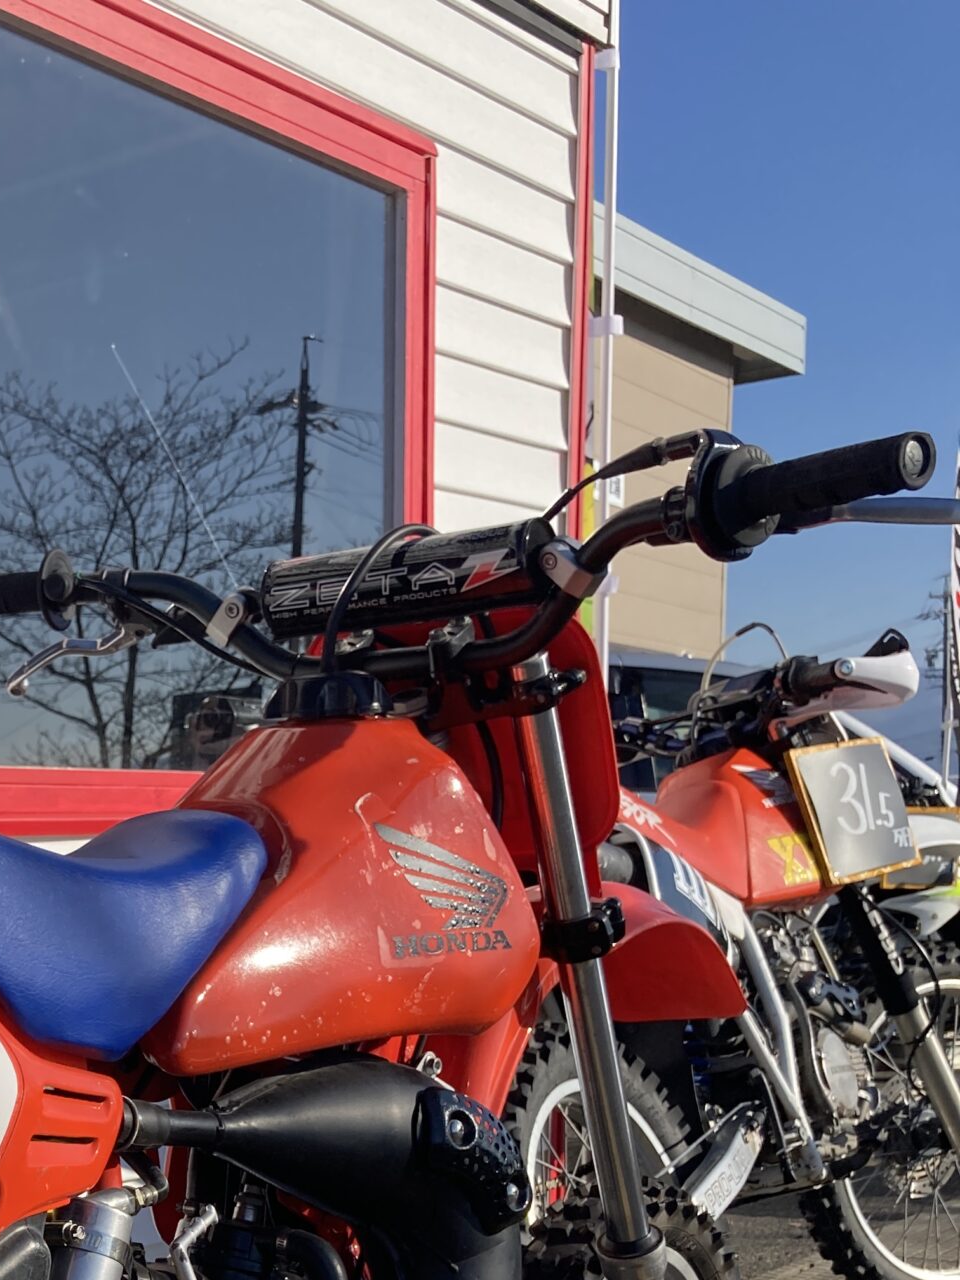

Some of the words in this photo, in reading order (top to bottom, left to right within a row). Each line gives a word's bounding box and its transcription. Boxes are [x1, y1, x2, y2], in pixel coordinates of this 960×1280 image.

[270, 561, 456, 612] ZETA
[303, 597, 387, 616] PERFMANCE
[393, 587, 457, 602] PRODUCTS
[392, 930, 512, 958] HONDA
